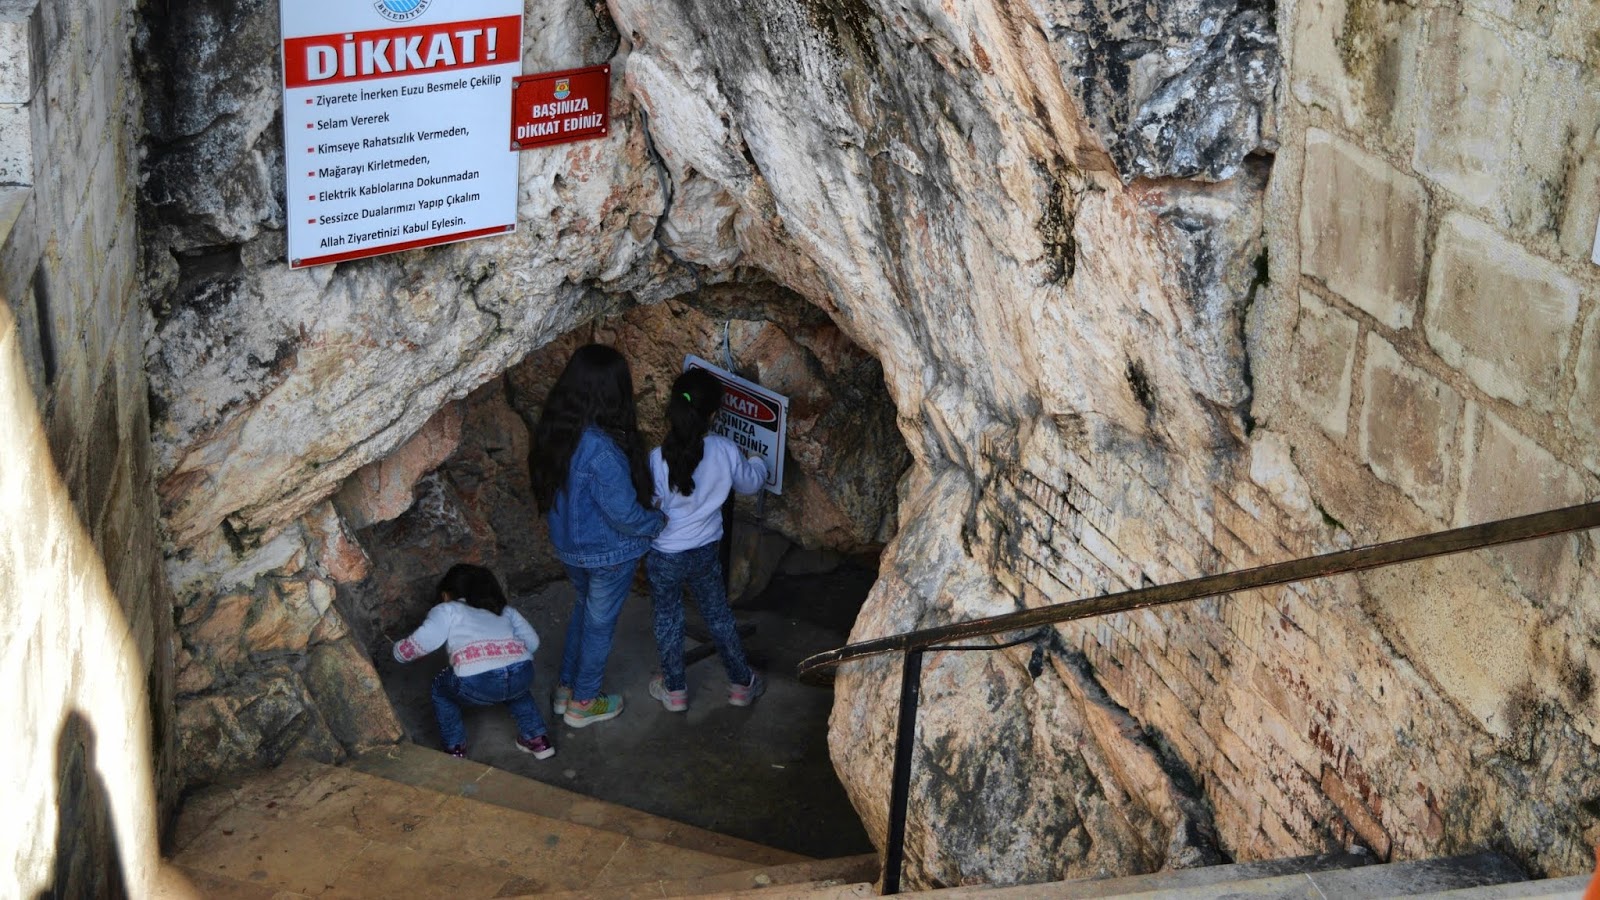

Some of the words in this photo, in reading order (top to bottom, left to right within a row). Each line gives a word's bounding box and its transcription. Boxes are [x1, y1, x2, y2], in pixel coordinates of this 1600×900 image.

[306, 27, 498, 81] DİKKAT!
[316, 92, 358, 107] Ziyarete
[360, 88, 398, 101] İnerken
[401, 86, 424, 96] Euzu
[427, 79, 468, 93] Besmele
[470, 74, 502, 89] Çekilip
[317, 118, 348, 130] Selam
[351, 112, 390, 126] Vererek
[532, 97, 589, 119] BAŞINIZA
[517, 120, 560, 139] DİKKAT
[563, 112, 603, 132] EDİNİZ
[318, 142, 360, 154] Kimseye
[363, 132, 415, 149] Rahatsızlık
[417, 126, 470, 141] Vermeden,
[319, 165, 365, 178] Mağarayı
[367, 155, 430, 172] Kirletmeden,
[319, 187, 357, 202] Elektrik
[359, 181, 414, 196] Kablolarına
[417, 170, 480, 187] Dokunmadan
[319, 212, 359, 225] Sessizce
[362, 203, 416, 219] Dualarımızı
[418, 199, 444, 210] Yapıp
[446, 192, 480, 207] Çıkalım
[320, 235, 345, 248] Allah
[347, 226, 400, 244] Ziyaretinizi
[402, 221, 429, 234] Kabul
[431, 216, 467, 231] Eylesin.
[733, 431, 769, 456] EDİNİZ
